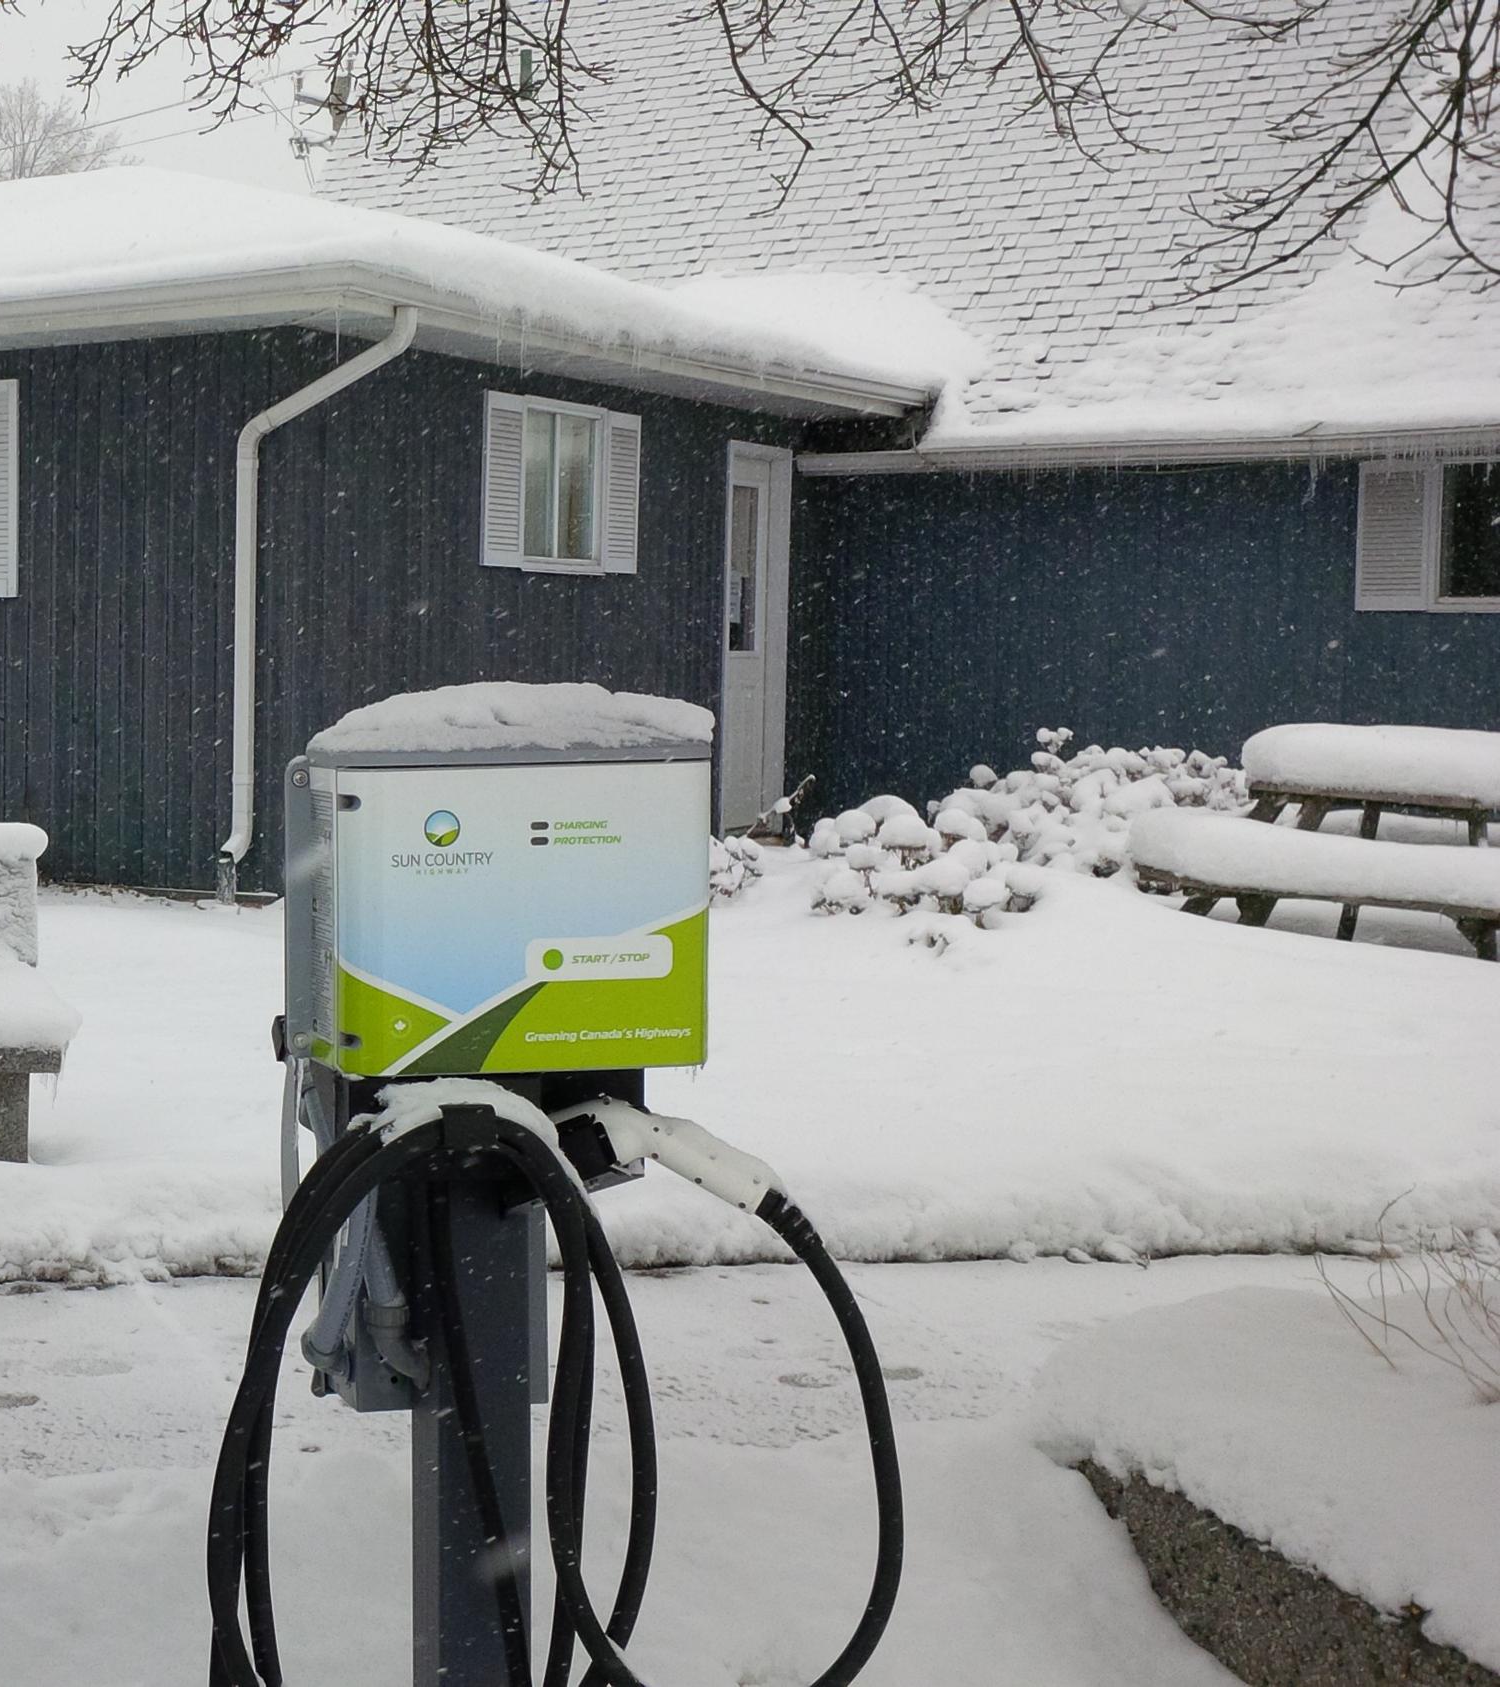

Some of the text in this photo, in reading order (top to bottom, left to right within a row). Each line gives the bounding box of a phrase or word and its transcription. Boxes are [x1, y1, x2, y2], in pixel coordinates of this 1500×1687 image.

[554, 821, 608, 830] CHARGING
[553, 835, 622, 845] PROTECTION
[391, 851, 494, 868] SUN COUNTRY
[415, 868, 469, 876] HIGHWAY
[525, 1027, 692, 1043] Greening Canada's Highways
